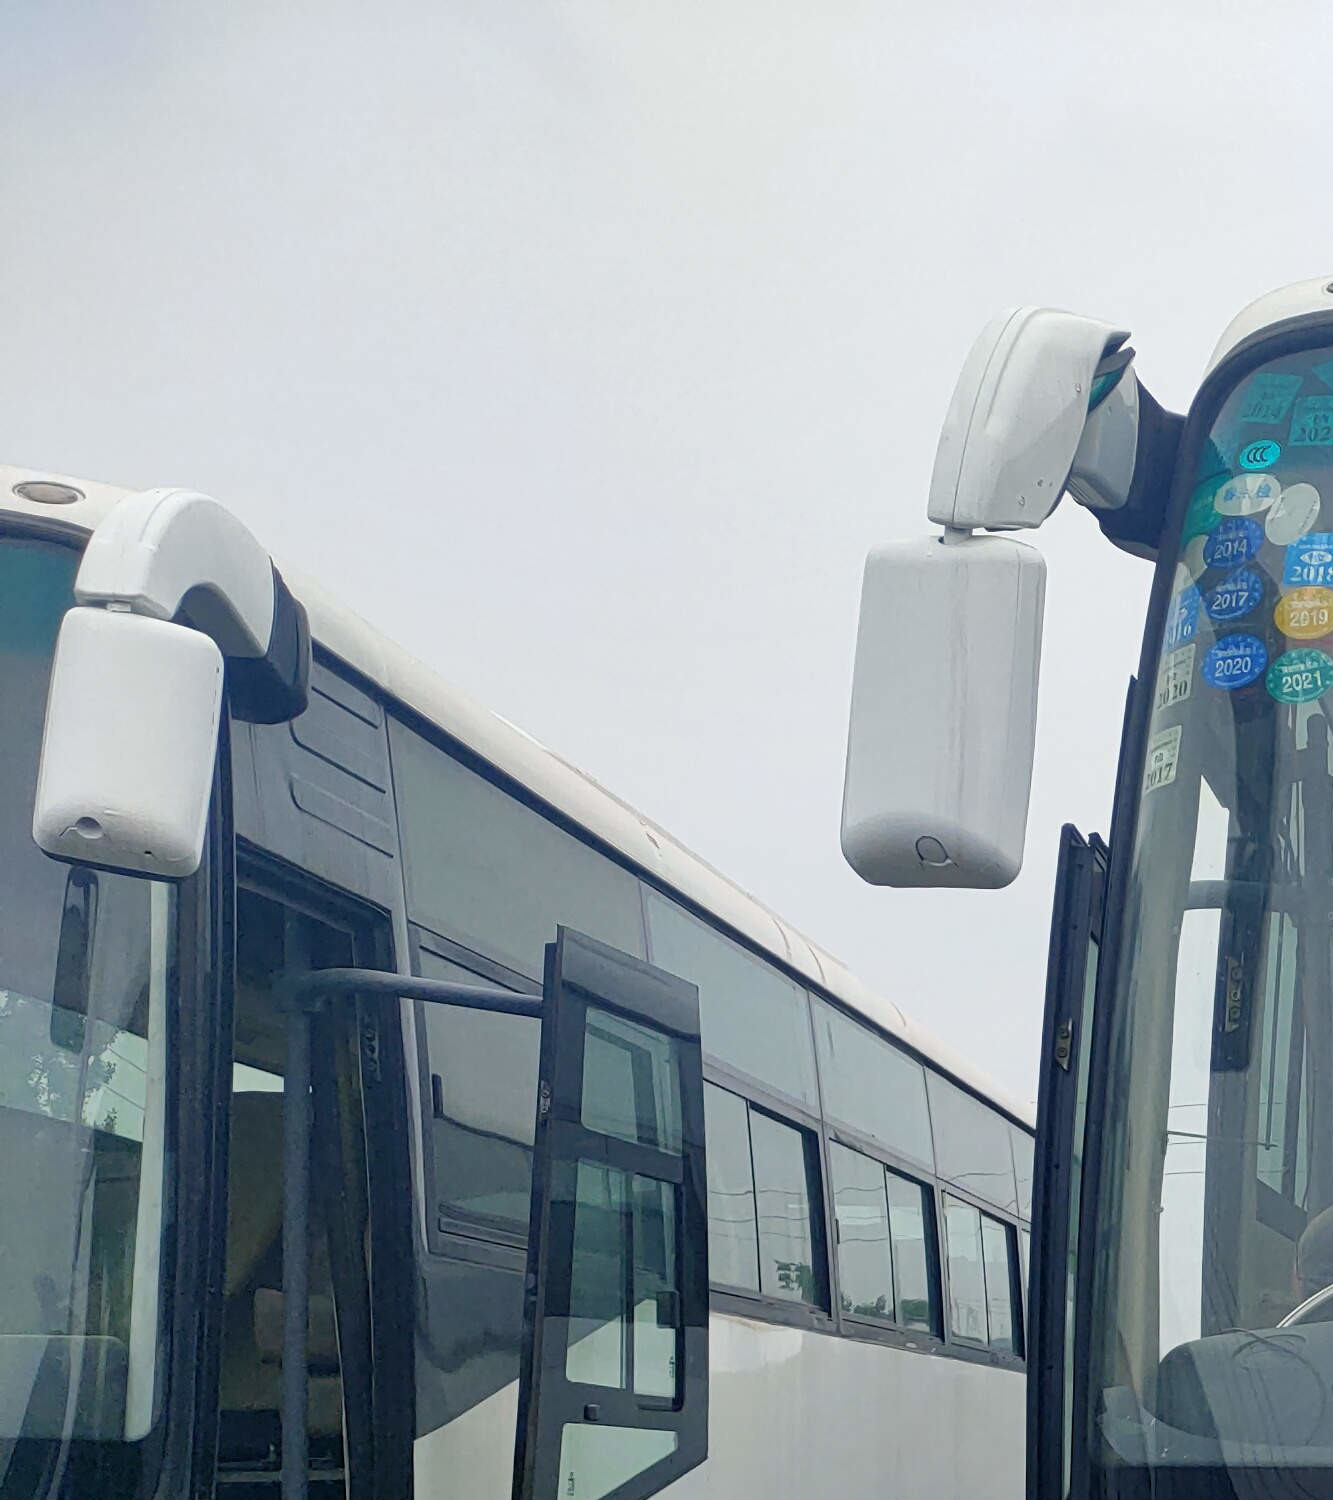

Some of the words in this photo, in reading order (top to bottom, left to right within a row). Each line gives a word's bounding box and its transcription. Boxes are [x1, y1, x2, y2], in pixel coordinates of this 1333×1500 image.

[1247, 445, 1273, 464] CCC
[1214, 539, 1248, 560] 2014
[1211, 592, 1249, 611] 2017
[1289, 609, 1329, 627] 2019
[1215, 656, 1252, 678] 2020
[1281, 670, 1323, 693] 2021
[1157, 679, 1189, 711] 2020
[1145, 762, 1173, 791] 2017
